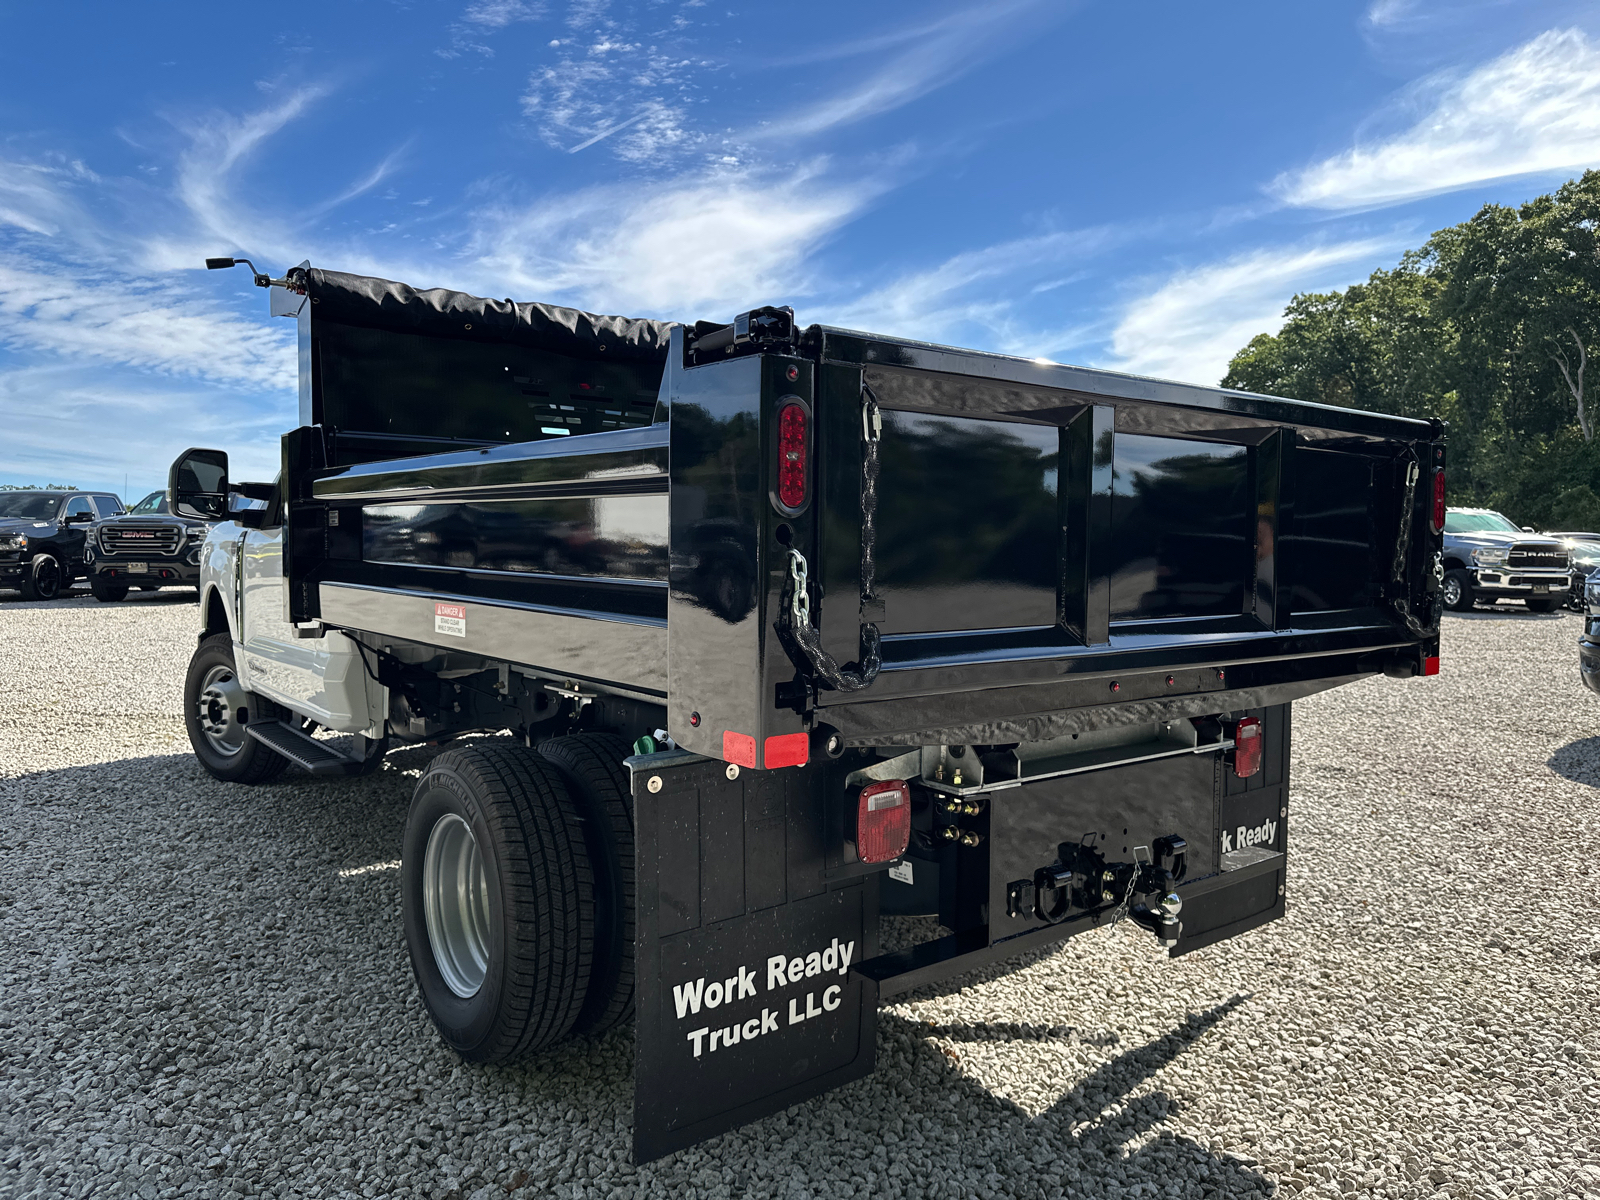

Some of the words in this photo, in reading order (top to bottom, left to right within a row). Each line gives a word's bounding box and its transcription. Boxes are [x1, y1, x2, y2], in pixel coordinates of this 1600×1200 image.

[441, 606, 459, 616] DANGER
[447, 626, 463, 634] OPERATING
[438, 774, 477, 817] MICHELIN
[1236, 818, 1277, 850] Ready
[672, 965, 757, 1019] Work
[767, 937, 855, 990] Ready
[686, 1007, 779, 1058] Truck
[788, 984, 842, 1026] LLC
